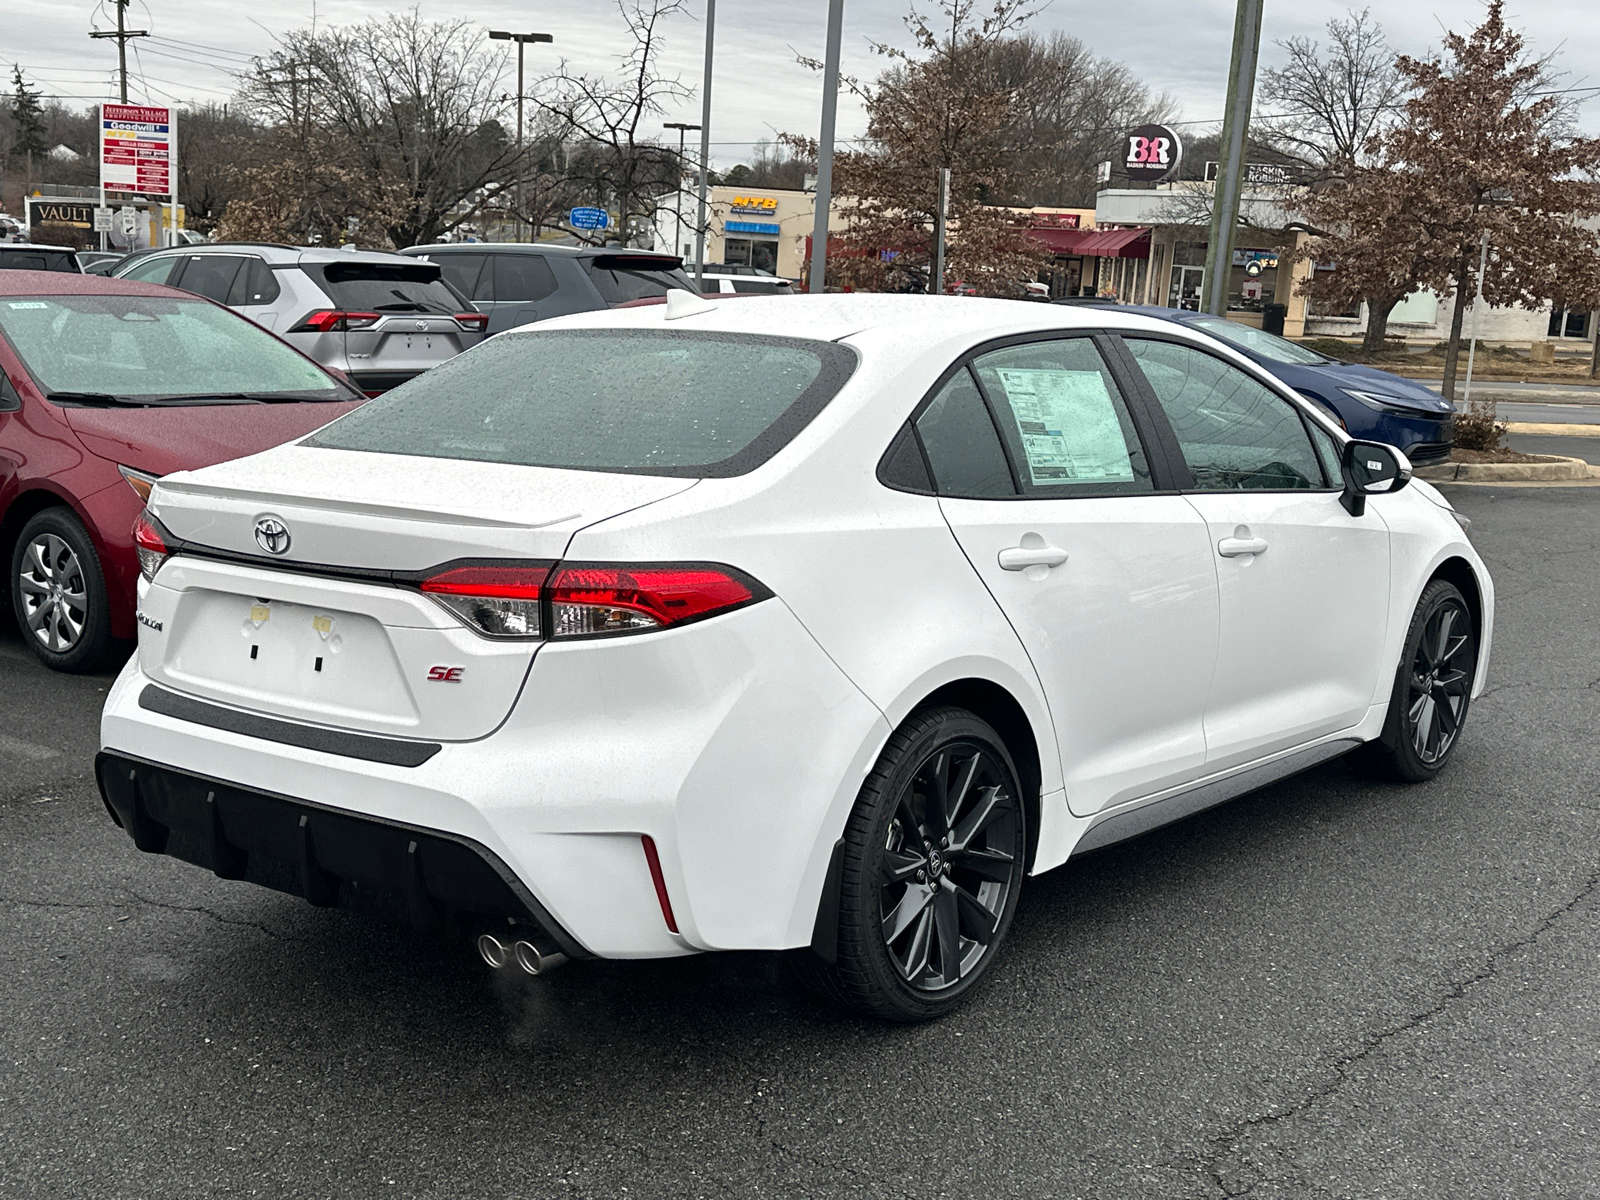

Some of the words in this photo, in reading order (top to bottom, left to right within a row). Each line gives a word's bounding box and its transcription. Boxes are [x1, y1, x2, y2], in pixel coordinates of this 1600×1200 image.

[140, 108, 167, 117] VILLAGE
[110, 122, 155, 132] Goodwill
[1249, 166, 1285, 176] BASKIN
[732, 196, 778, 209] NTB
[38, 205, 90, 221] VAULT
[426, 665, 465, 683] SE
